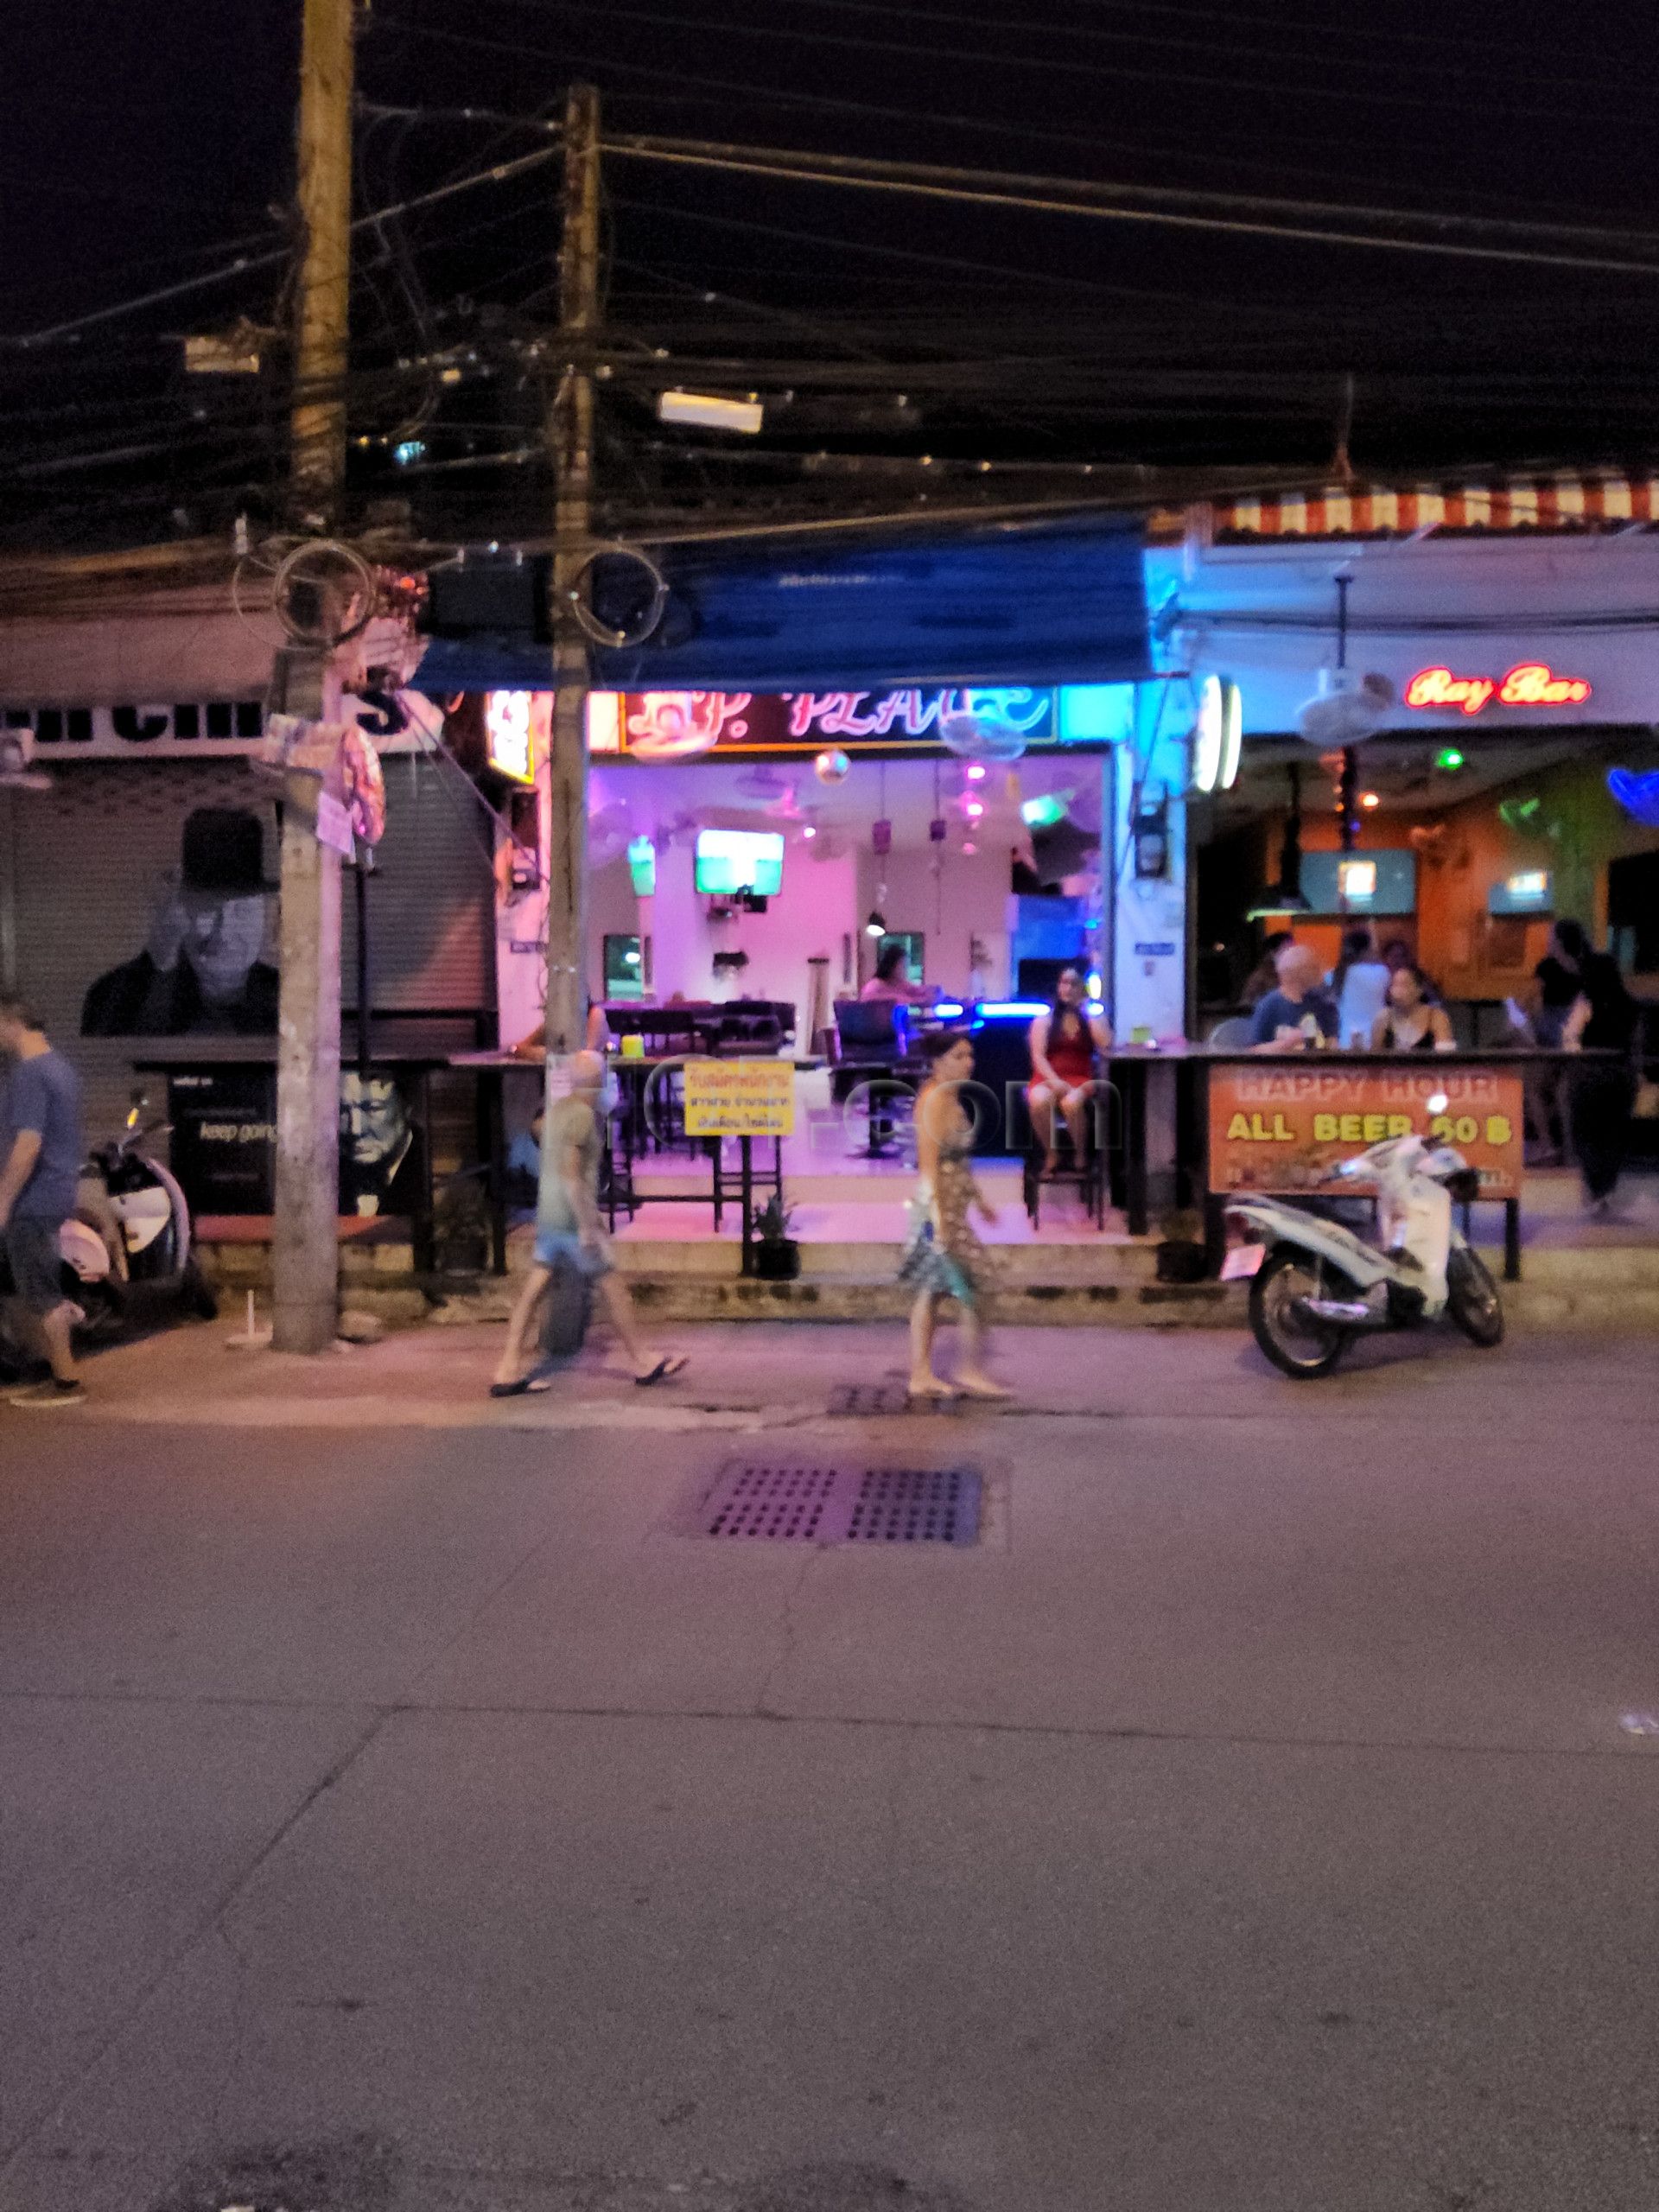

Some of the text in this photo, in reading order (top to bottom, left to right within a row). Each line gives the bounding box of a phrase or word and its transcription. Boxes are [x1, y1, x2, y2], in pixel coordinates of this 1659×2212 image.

[1499, 662, 1592, 705] Bar
[1236, 1068, 1498, 1103] HAPPY HOUR
[200, 1122, 238, 1141] keep
[1227, 1113, 1295, 1141] ALL
[1313, 1114, 1413, 1142] BEER
